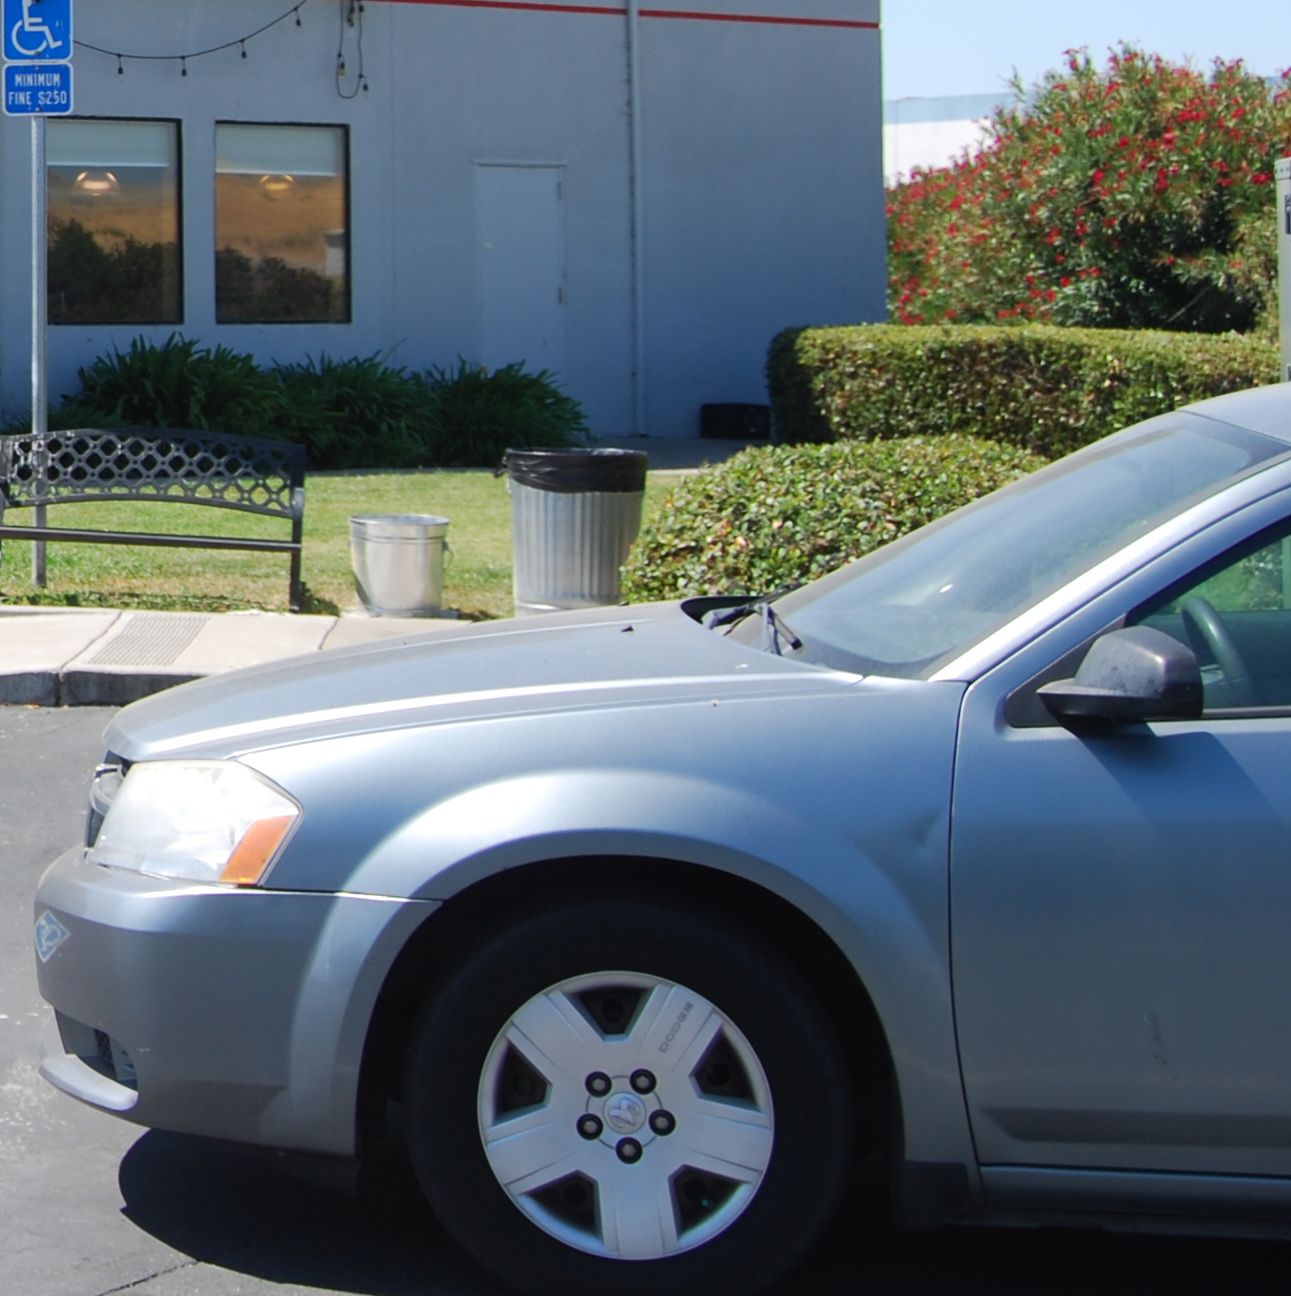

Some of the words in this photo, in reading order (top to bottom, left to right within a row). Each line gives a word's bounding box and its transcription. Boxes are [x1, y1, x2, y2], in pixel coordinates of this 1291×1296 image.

[14, 73, 61, 87] MINIMUM
[8, 91, 32, 105] FINE
[37, 90, 67, 105] $250
[658, 1001, 693, 1053] DODGE
